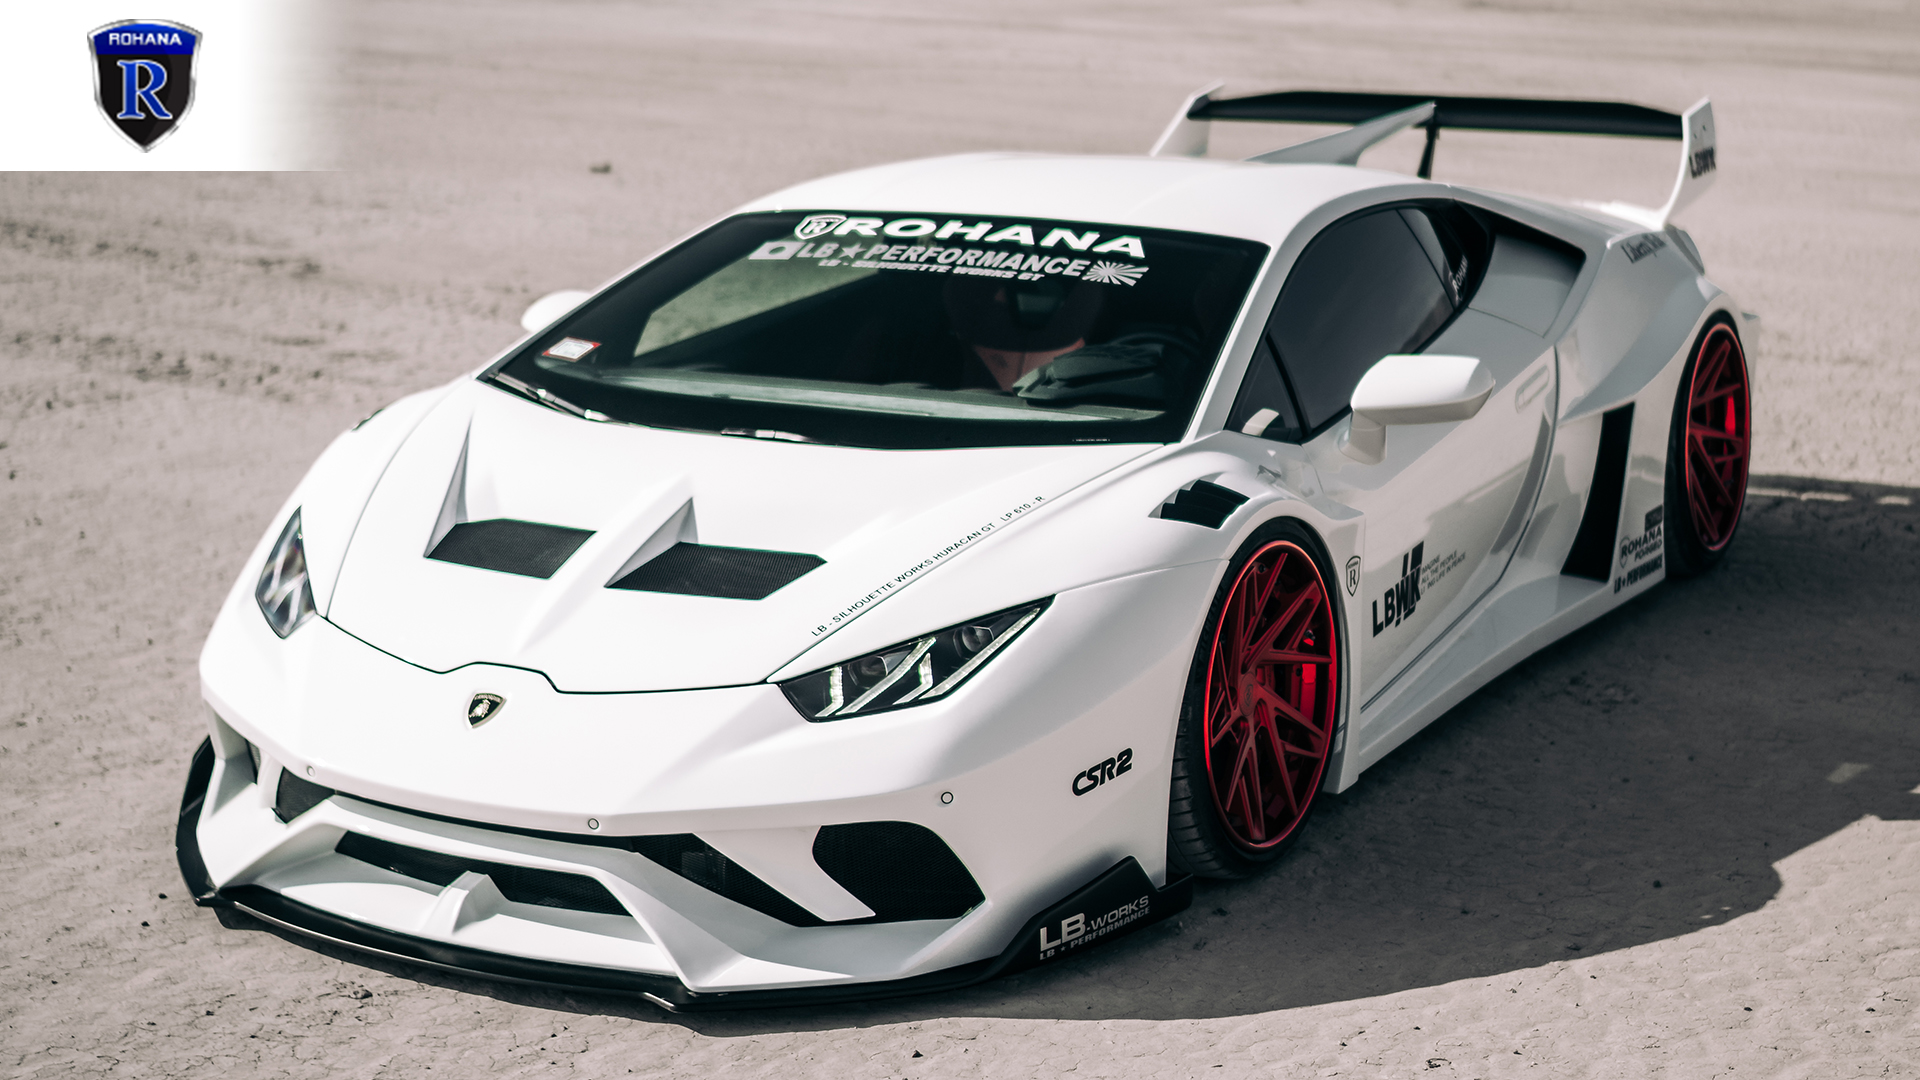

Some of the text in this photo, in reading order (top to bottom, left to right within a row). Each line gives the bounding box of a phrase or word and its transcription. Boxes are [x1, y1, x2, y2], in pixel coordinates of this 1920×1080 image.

[797, 242, 1091, 277] LB PERFORMANCE
[833, 216, 1145, 258] ROHANA
[952, 266, 1018, 278] WORKS
[1017, 272, 1045, 281] GT
[1621, 526, 1662, 559] ROHANA
[811, 624, 827, 637] LB
[832, 581, 896, 623] SILHOUETTE
[894, 558, 934, 583] WORKS
[932, 530, 982, 561] HURACAN
[980, 521, 996, 534] GT
[1000, 511, 1013, 522] LP
[1013, 502, 1032, 515] 610
[1372, 541, 1424, 638] LBWK
[1072, 747, 1133, 797] CSR2
[1040, 905, 1151, 960] LB PERFORMANCE
